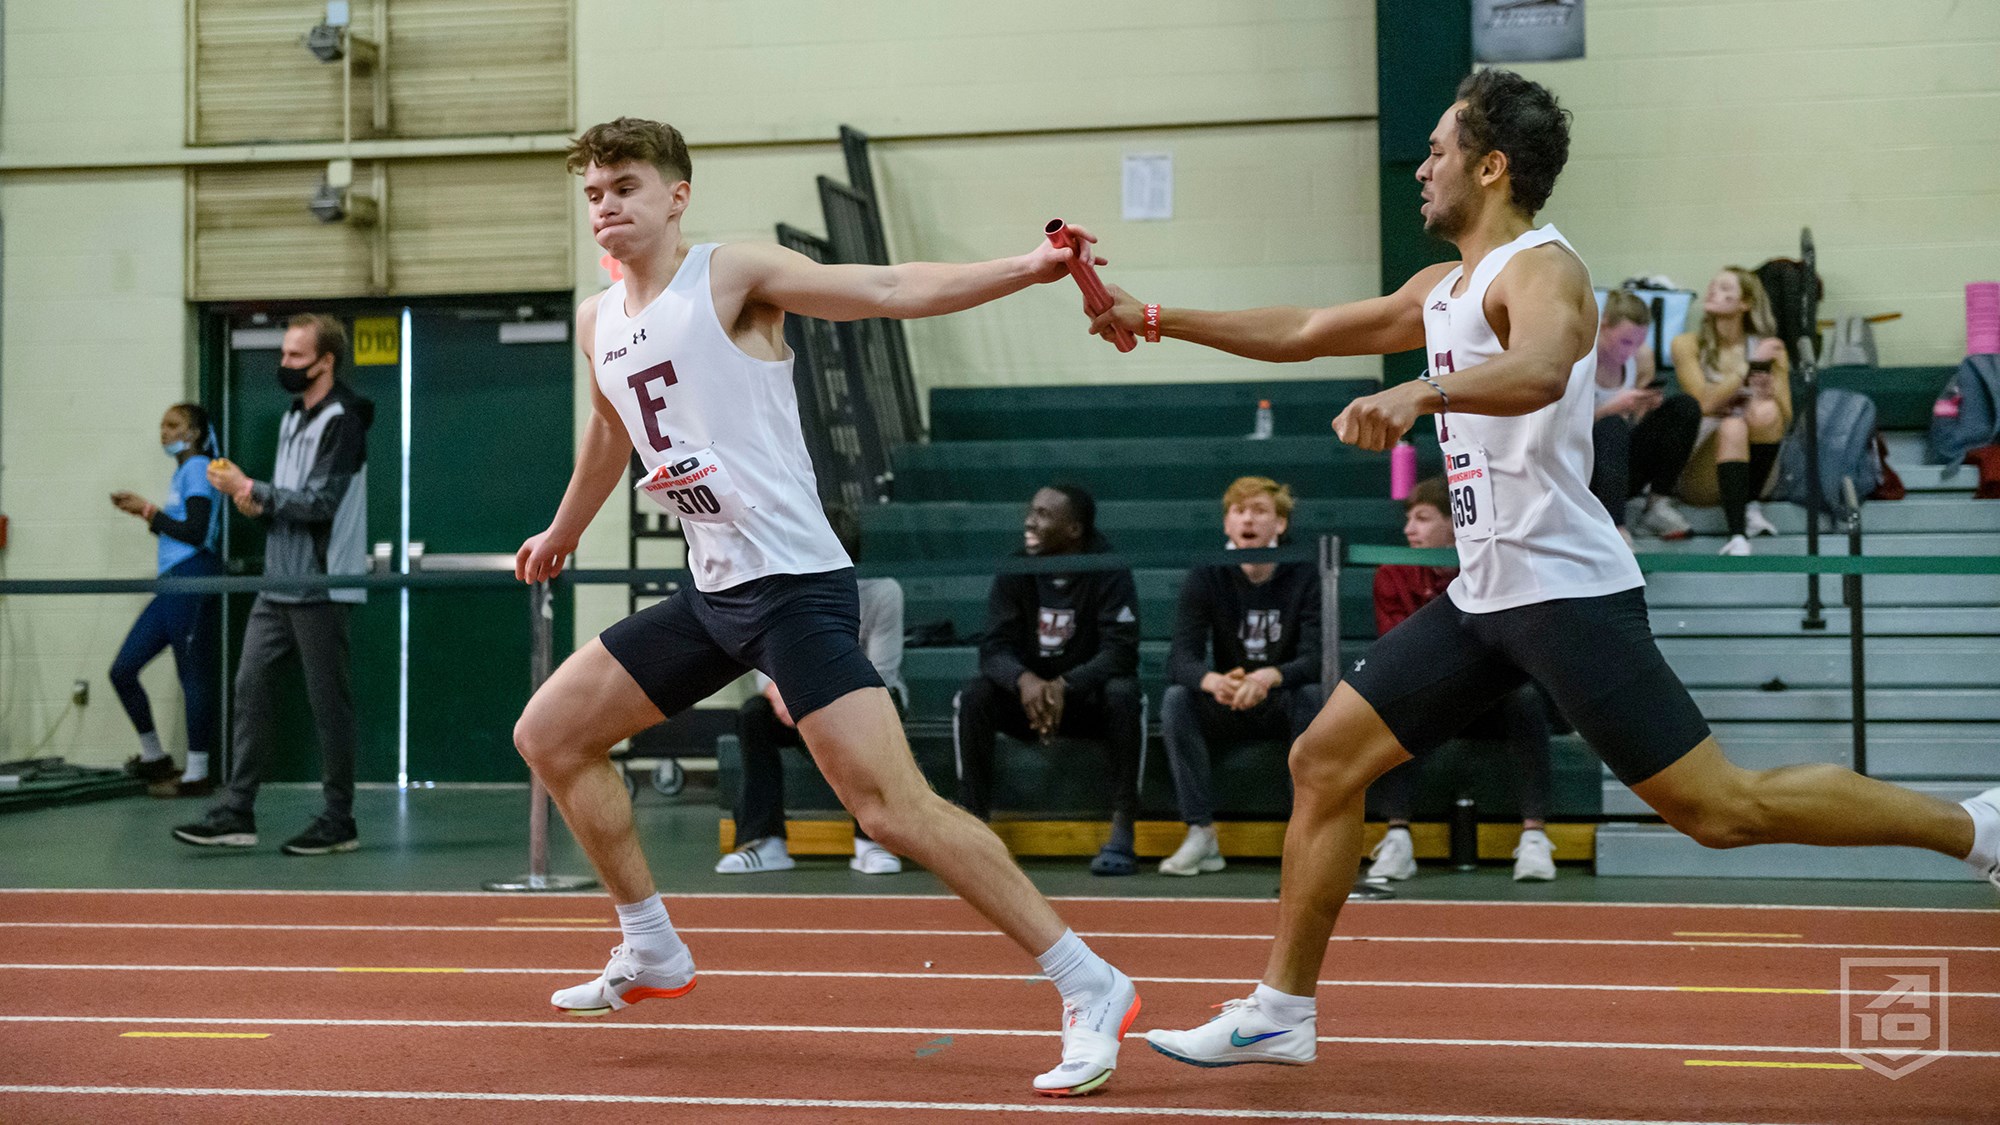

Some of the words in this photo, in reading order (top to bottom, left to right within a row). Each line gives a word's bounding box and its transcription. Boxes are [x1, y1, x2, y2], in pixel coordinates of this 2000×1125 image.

[603, 347, 627, 365] A10
[627, 360, 678, 452] F
[645, 464, 718, 492] CHAMPIONSHIPS
[651, 457, 700, 483] A10
[666, 485, 721, 515] 370
